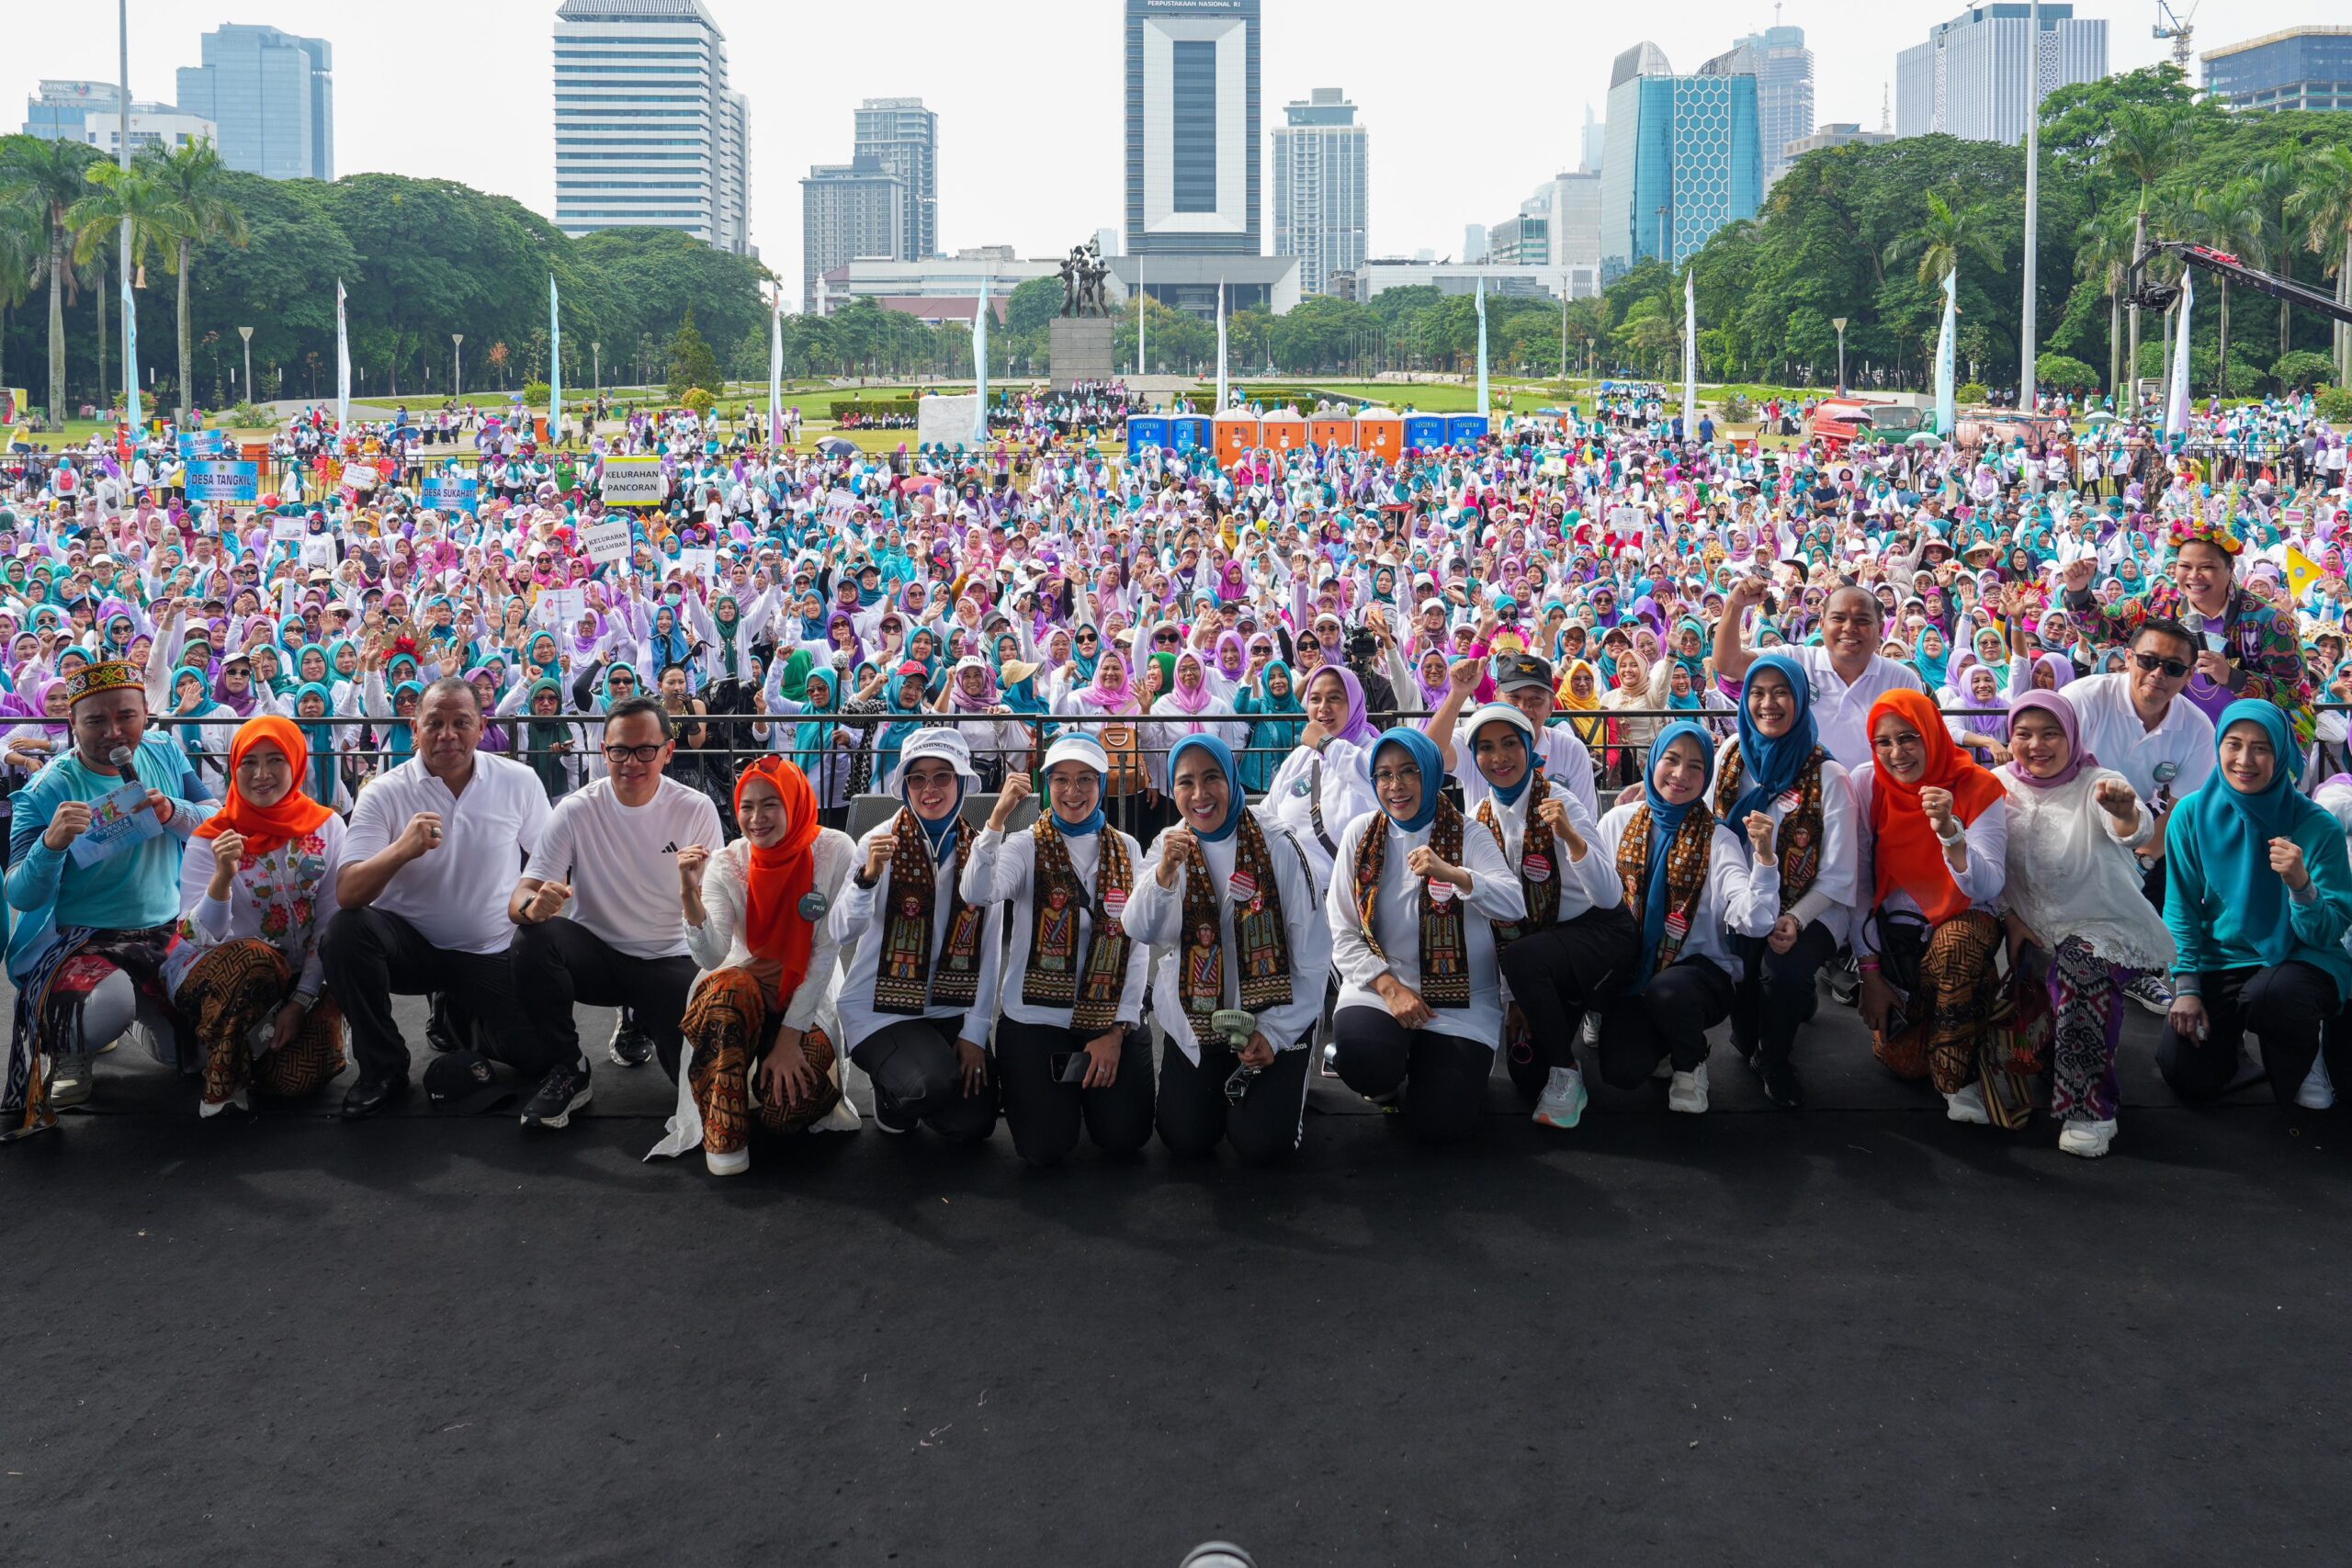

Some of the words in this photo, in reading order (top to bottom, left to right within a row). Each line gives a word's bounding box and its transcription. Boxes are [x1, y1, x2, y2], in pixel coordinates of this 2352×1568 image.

[42, 83, 73, 92] MNC
[605, 470, 659, 479] KELURAHAN
[191, 474, 214, 485] DESA
[216, 474, 252, 486] TANGKIL
[607, 483, 657, 491] PANCORAN
[424, 488, 441, 497] DESA
[443, 489, 475, 498] SUKAHATI
[588, 533, 628, 546] KELURAHAN
[594, 541, 628, 553] JELAMBAR
[913, 742, 956, 751] WASHINGTON
[812, 904, 826, 912] PKK
